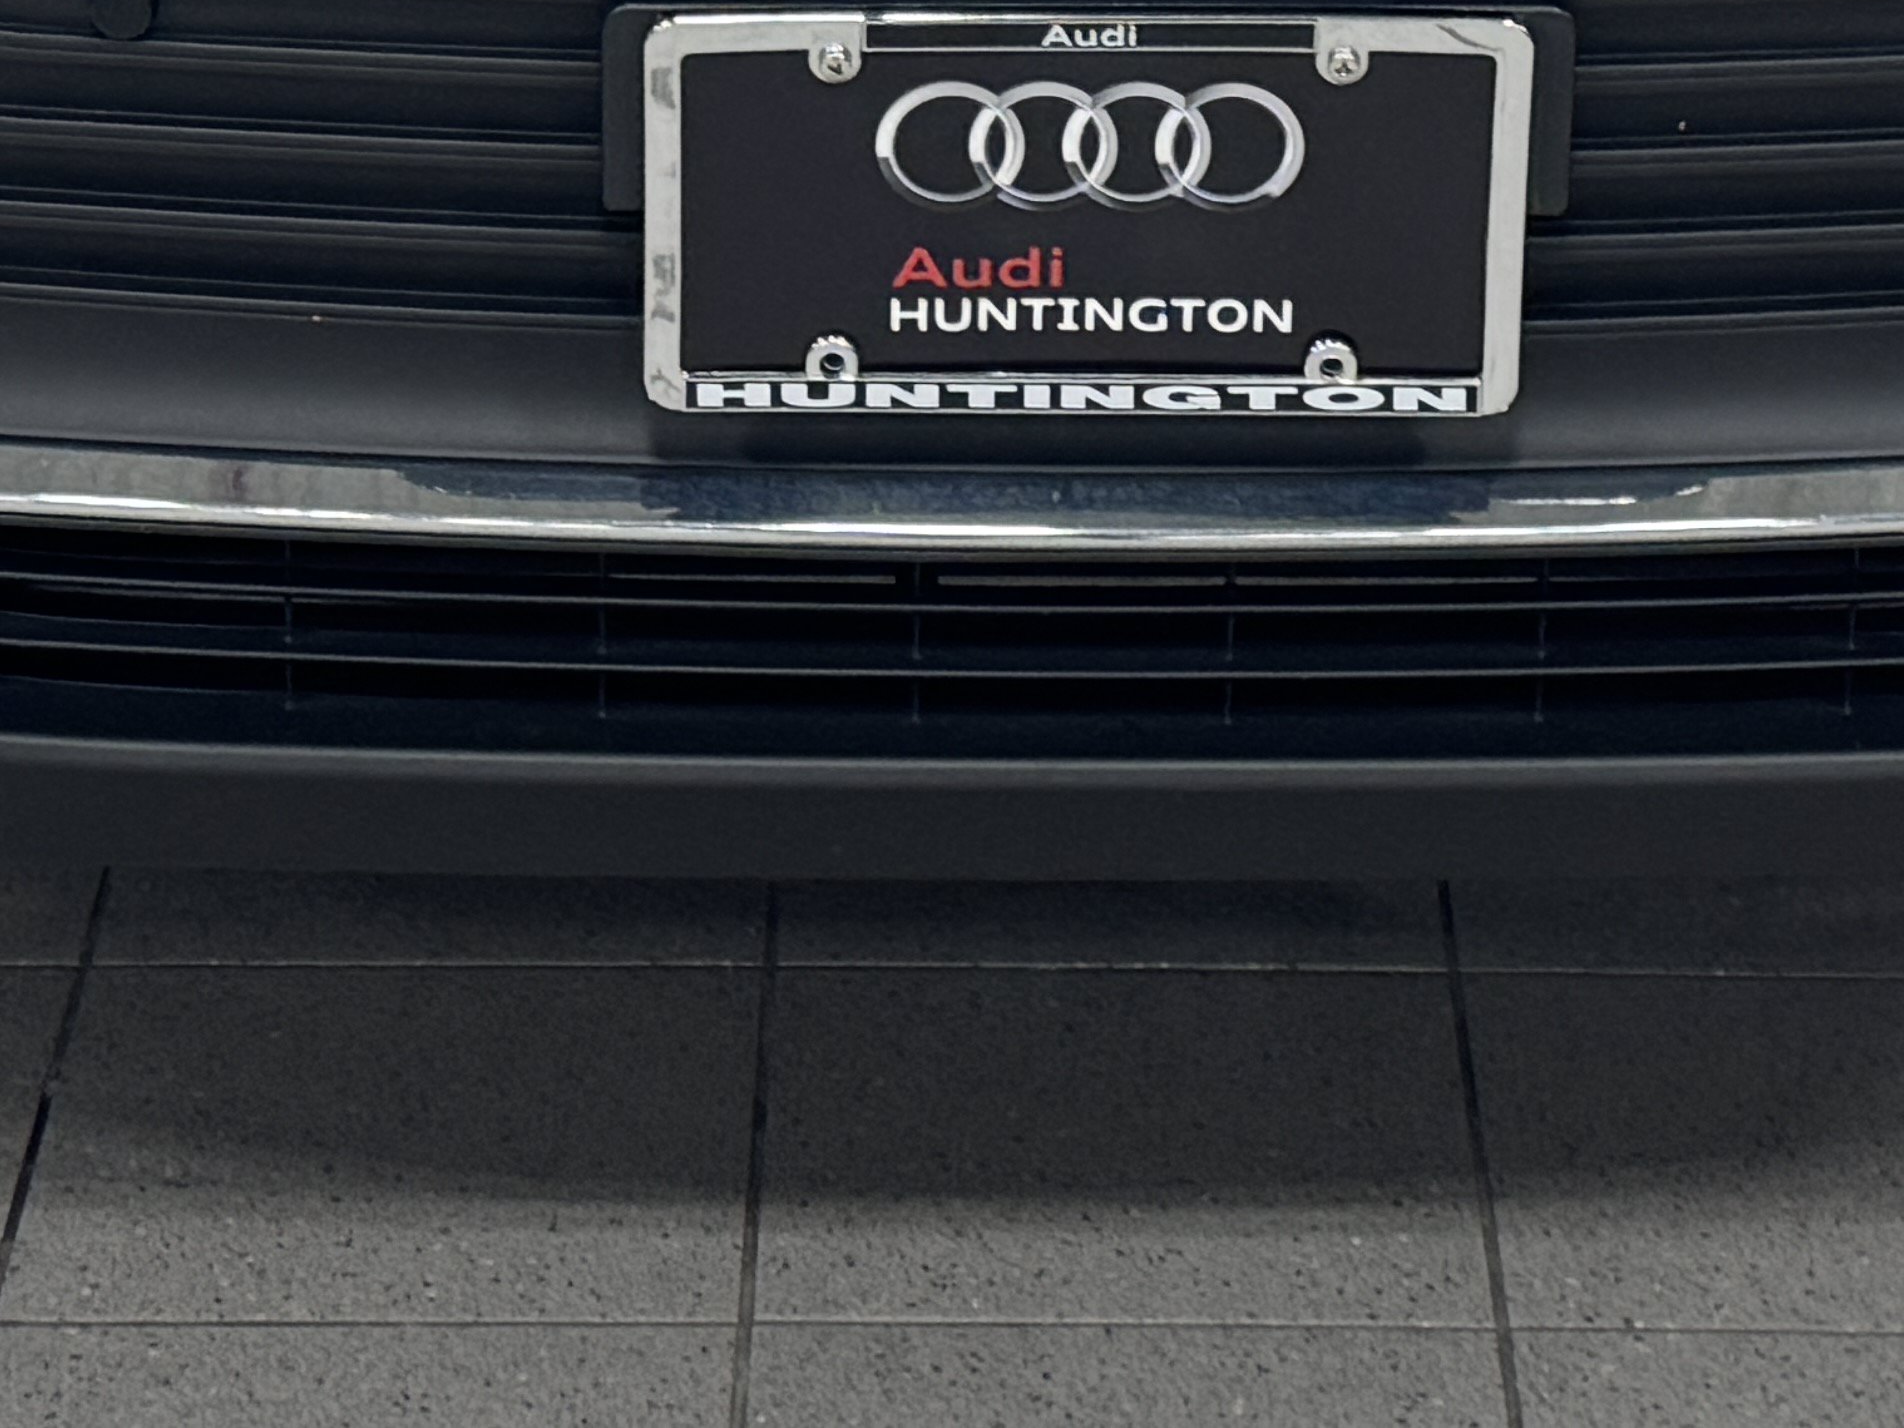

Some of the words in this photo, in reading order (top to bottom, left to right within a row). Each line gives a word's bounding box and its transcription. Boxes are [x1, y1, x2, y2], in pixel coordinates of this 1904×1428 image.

[1041, 23, 1137, 47] Audi
[892, 246, 1065, 289] Audi
[889, 297, 1293, 333] HUNTINGTON
[696, 382, 1467, 412] HUNTINGTON
